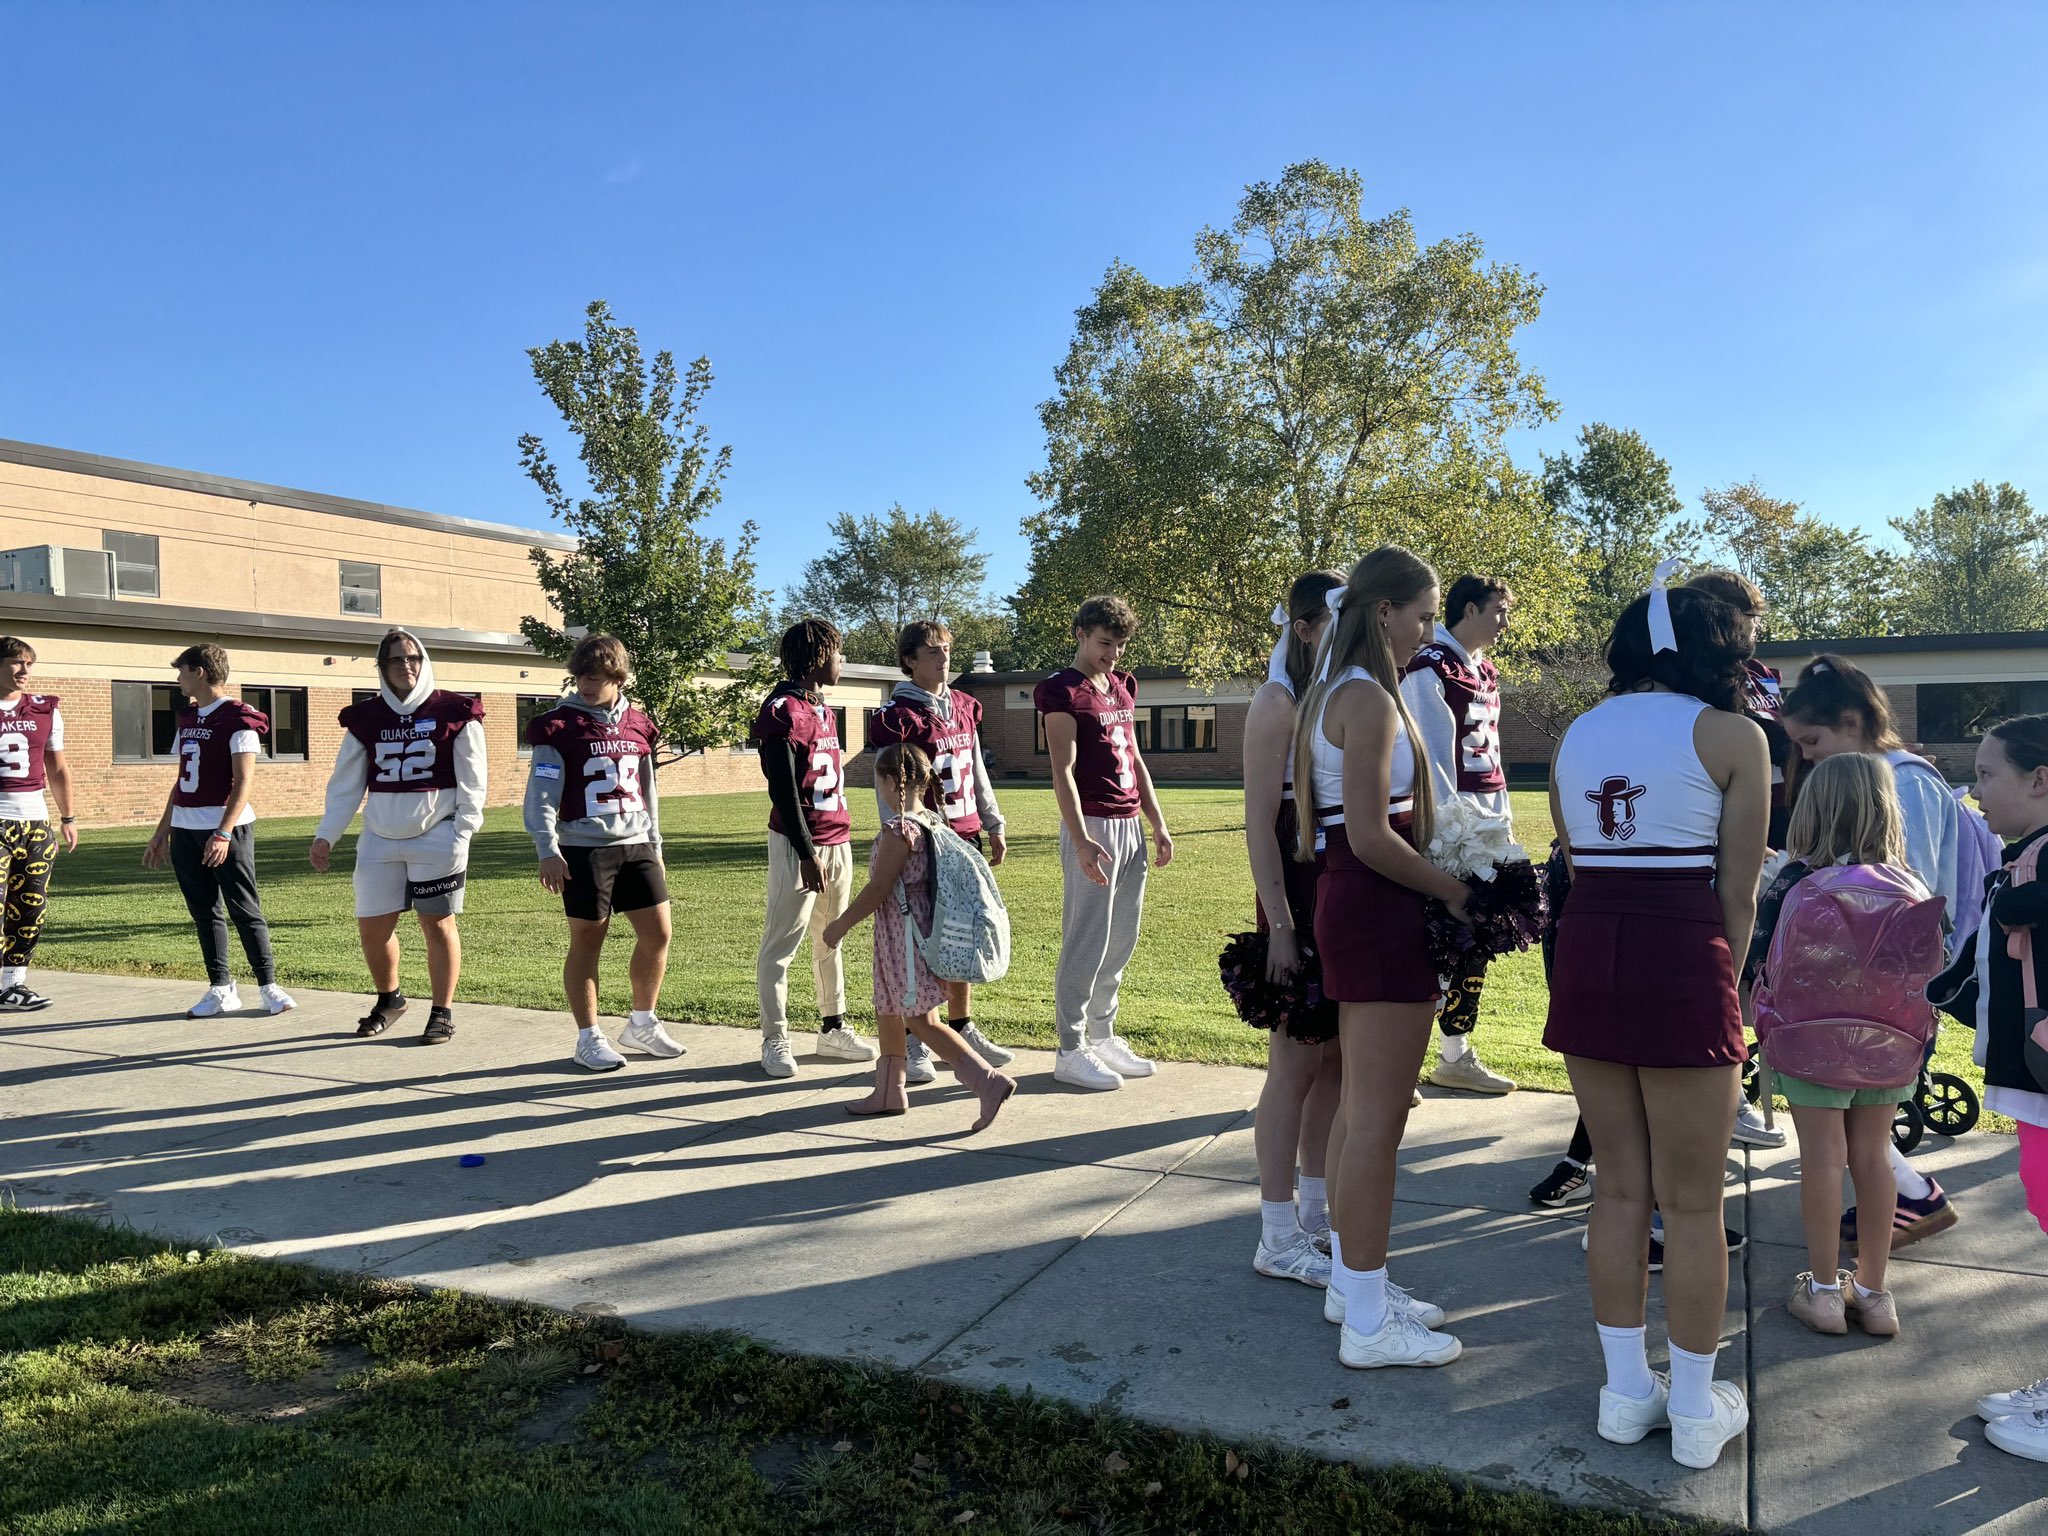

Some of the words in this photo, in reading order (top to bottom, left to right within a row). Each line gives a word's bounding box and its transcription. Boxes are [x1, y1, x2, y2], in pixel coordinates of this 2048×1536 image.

[0, 720, 37, 732] AKERS
[1099, 709, 1133, 725] QUAKERS
[180, 728, 213, 740] QUAKERS
[935, 733, 971, 752] QUAKERS
[590, 740, 639, 755] QUAKERS
[1111, 725, 1134, 789] 1
[179, 742, 201, 793] 3
[374, 739, 437, 782] 52
[583, 754, 645, 817] 29
[932, 749, 978, 819] 22
[413, 886, 437, 895] Calvin
[437, 880, 458, 891] Klein
